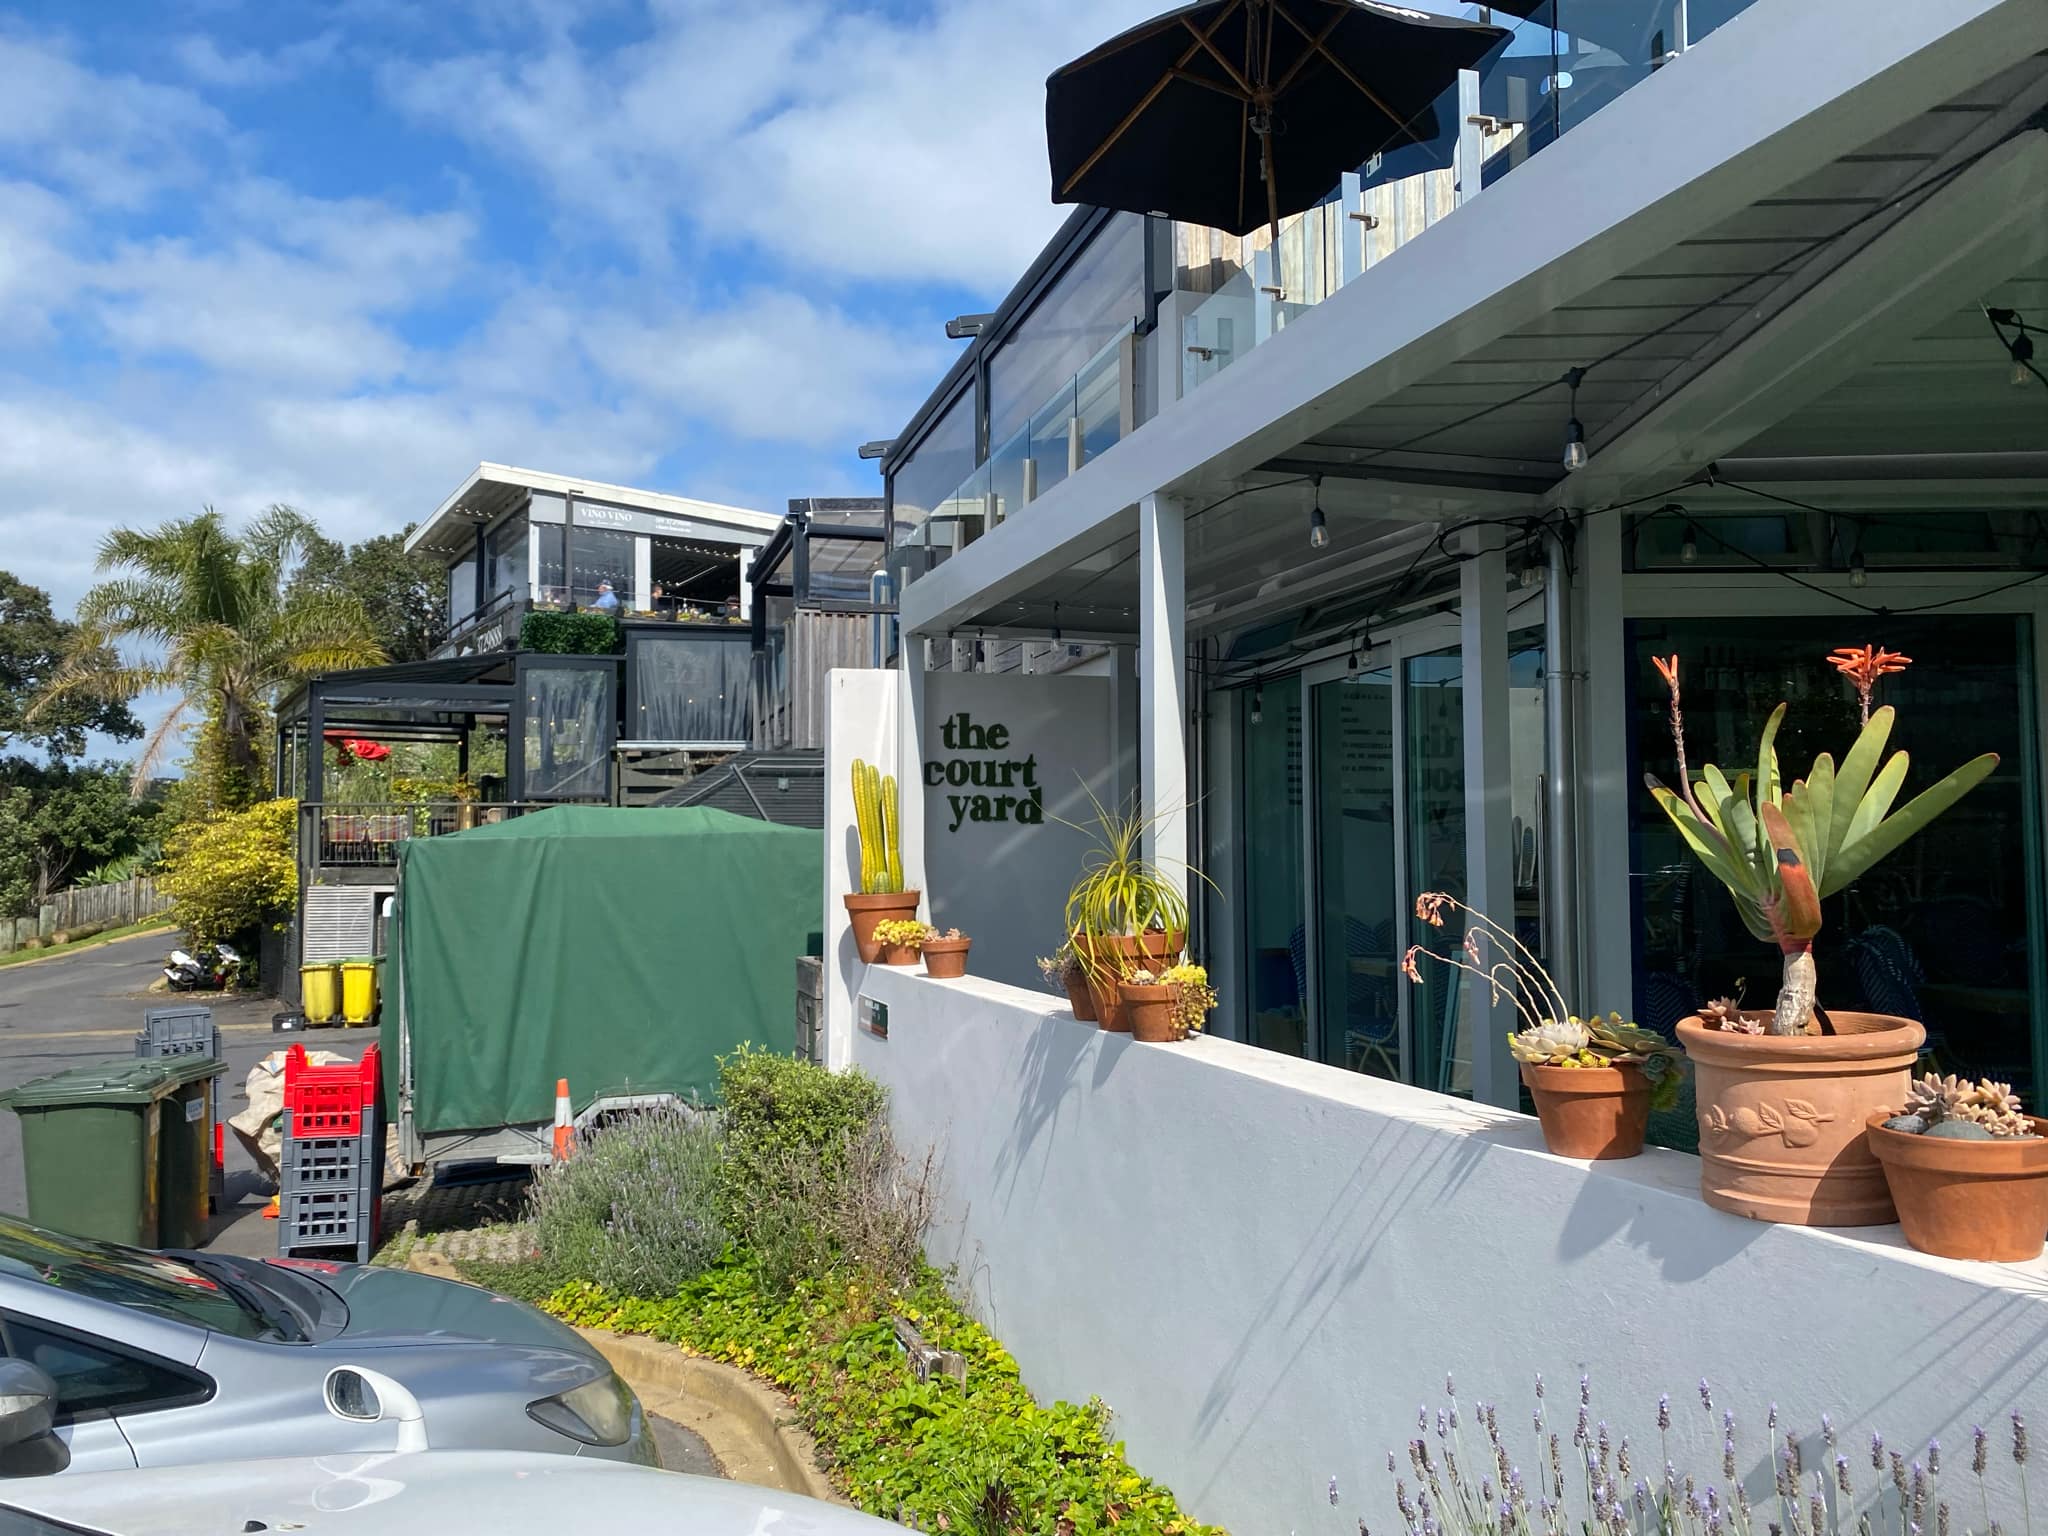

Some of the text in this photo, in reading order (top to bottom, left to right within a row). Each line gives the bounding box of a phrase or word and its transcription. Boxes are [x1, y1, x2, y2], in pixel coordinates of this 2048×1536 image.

[581, 508, 632, 521] VINO VINO
[939, 712, 1010, 750] the
[923, 753, 1038, 788] court
[946, 786, 1045, 833] yard
